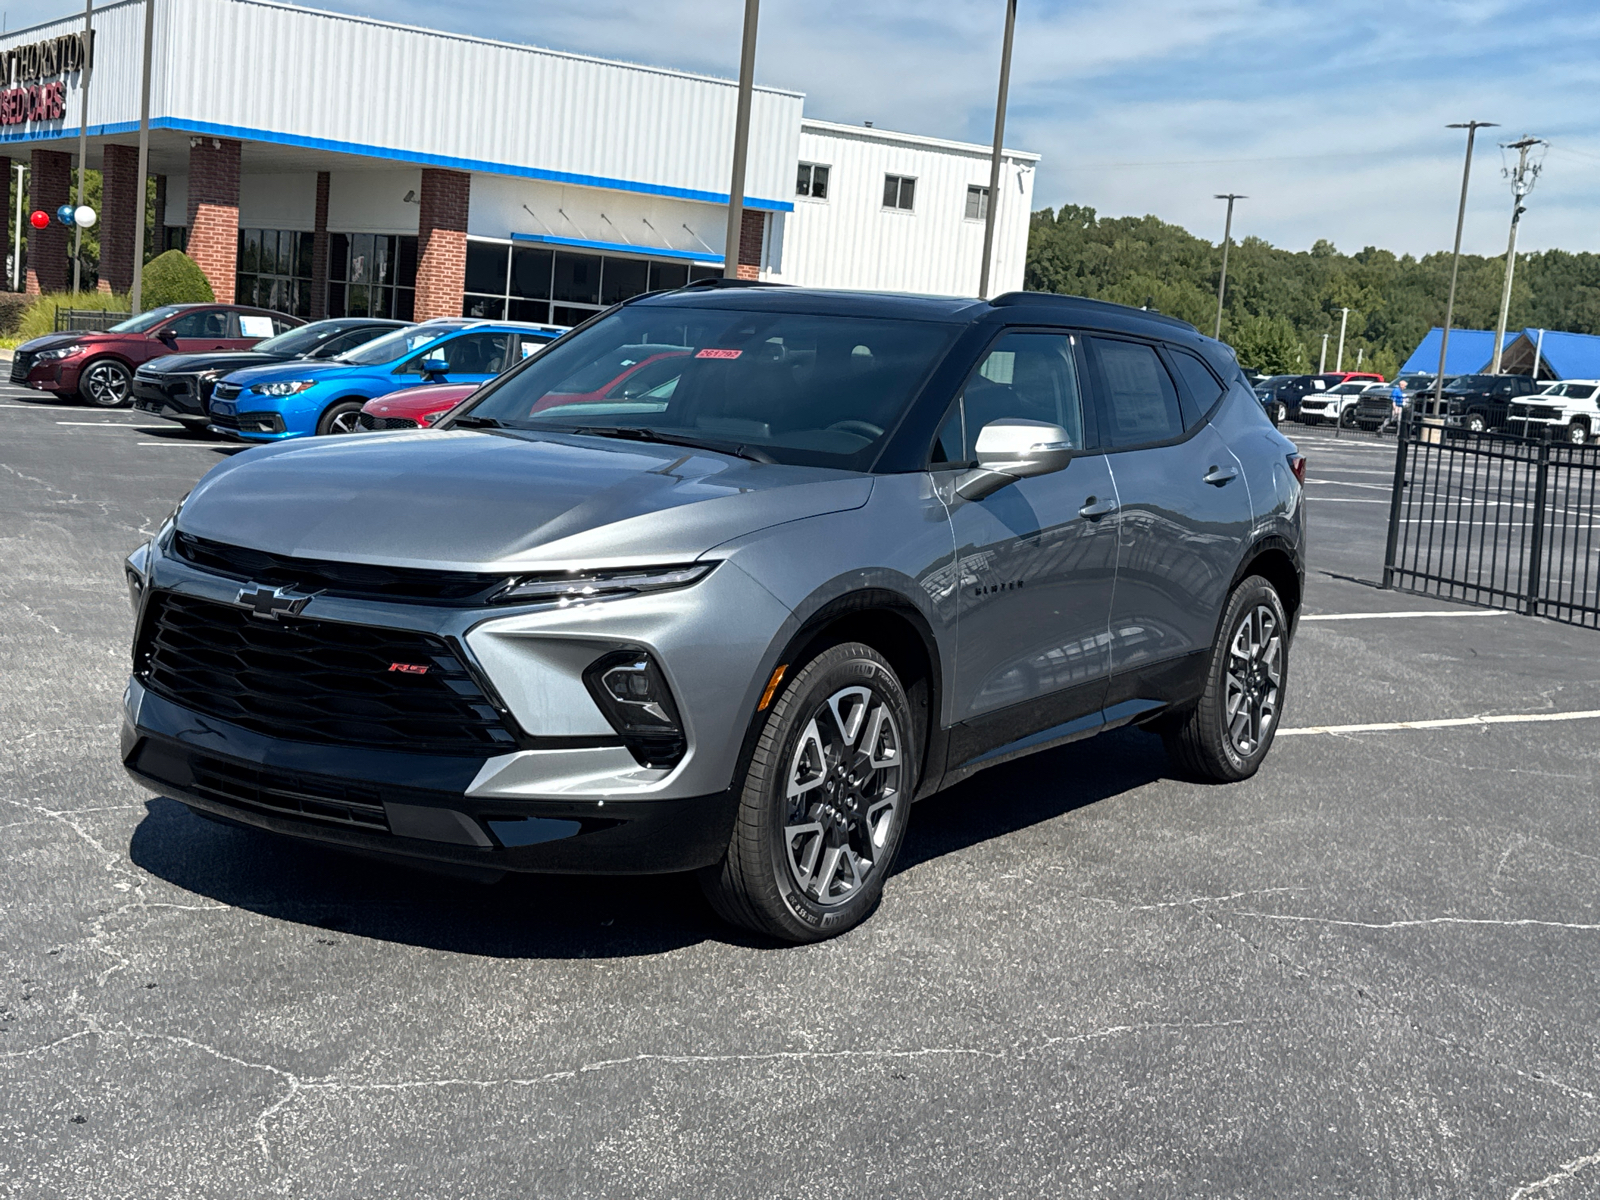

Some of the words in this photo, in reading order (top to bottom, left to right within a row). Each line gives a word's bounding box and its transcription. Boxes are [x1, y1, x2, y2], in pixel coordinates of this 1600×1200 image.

[0, 86, 27, 124] SED
[27, 81, 66, 122] CARS
[388, 662, 428, 674] RS
